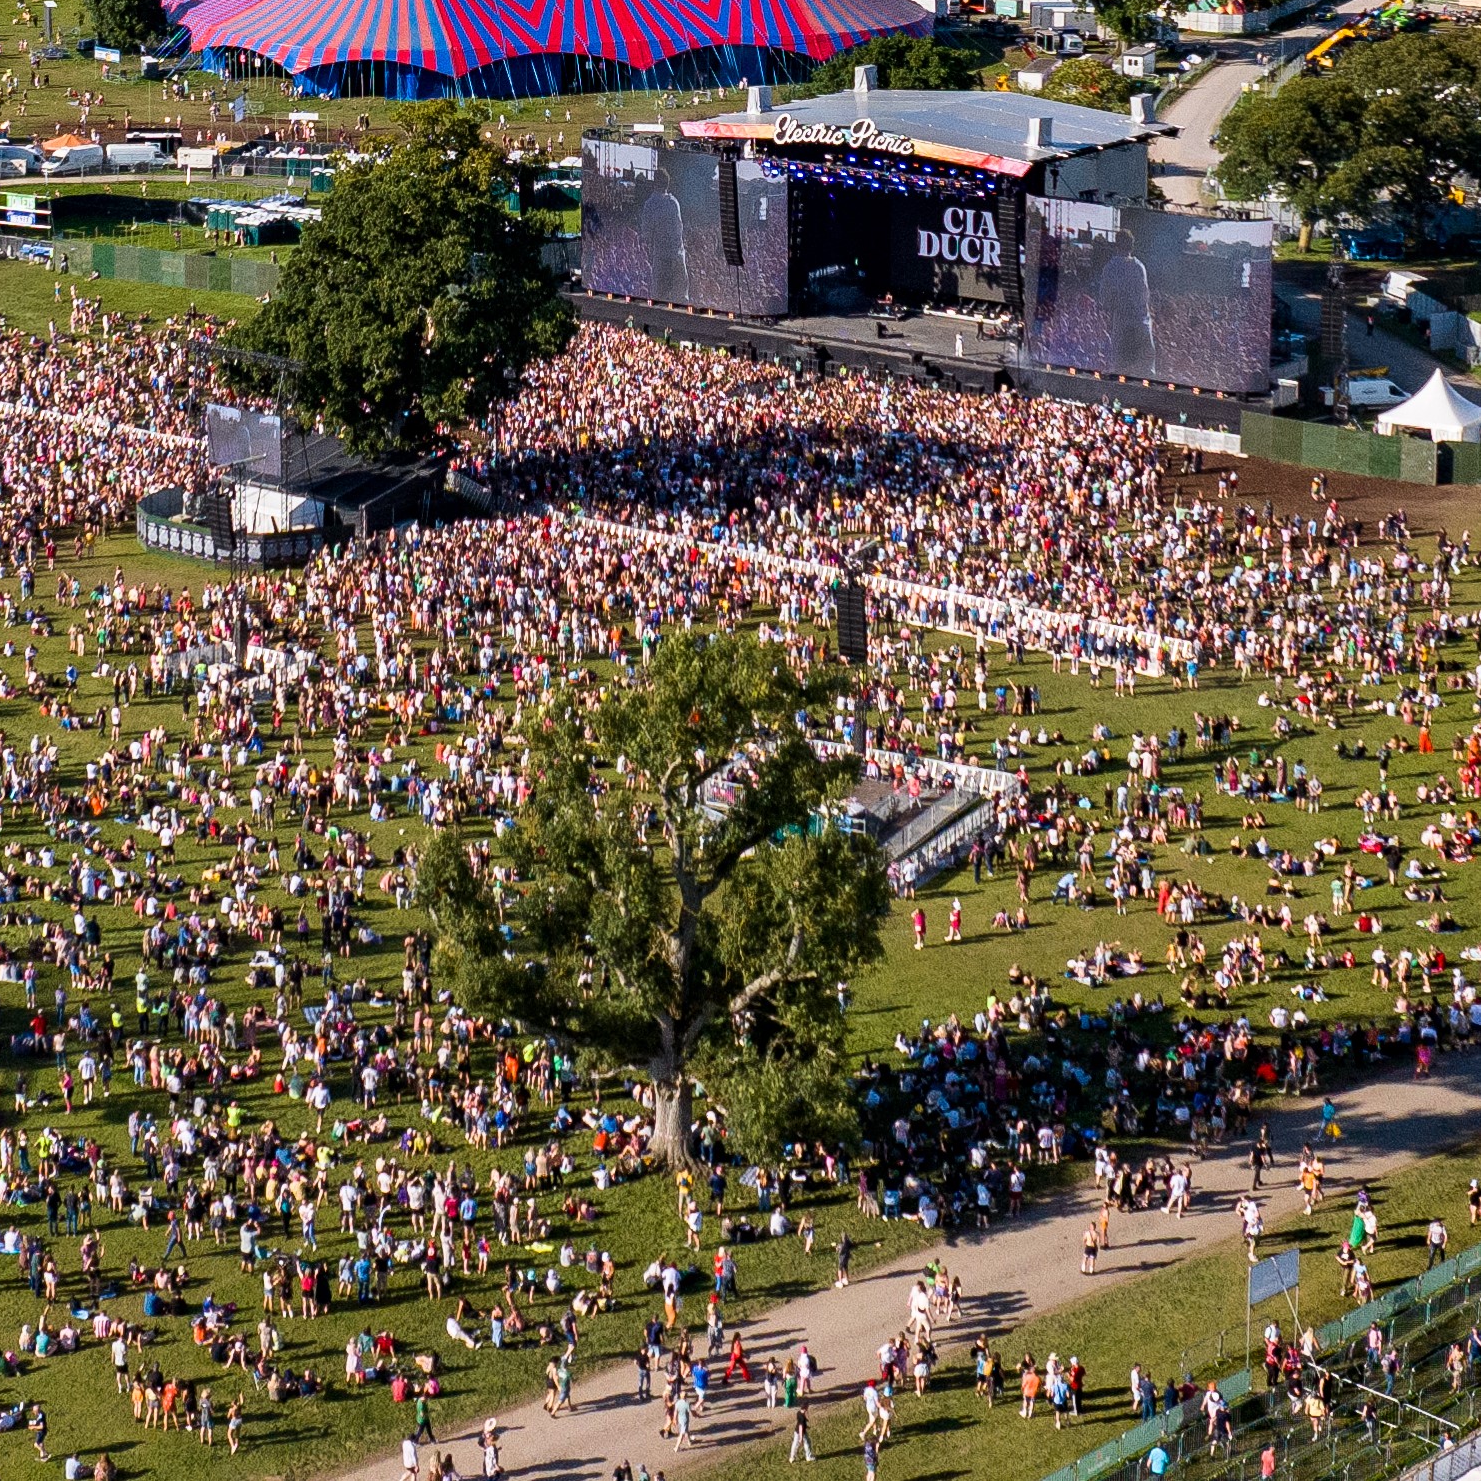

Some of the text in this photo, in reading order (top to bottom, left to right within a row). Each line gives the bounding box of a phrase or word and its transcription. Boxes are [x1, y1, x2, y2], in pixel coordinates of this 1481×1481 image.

[773, 113, 915, 155] Electric Picnic
[943, 207, 998, 239] CIA
[918, 230, 1002, 267] DUCR
